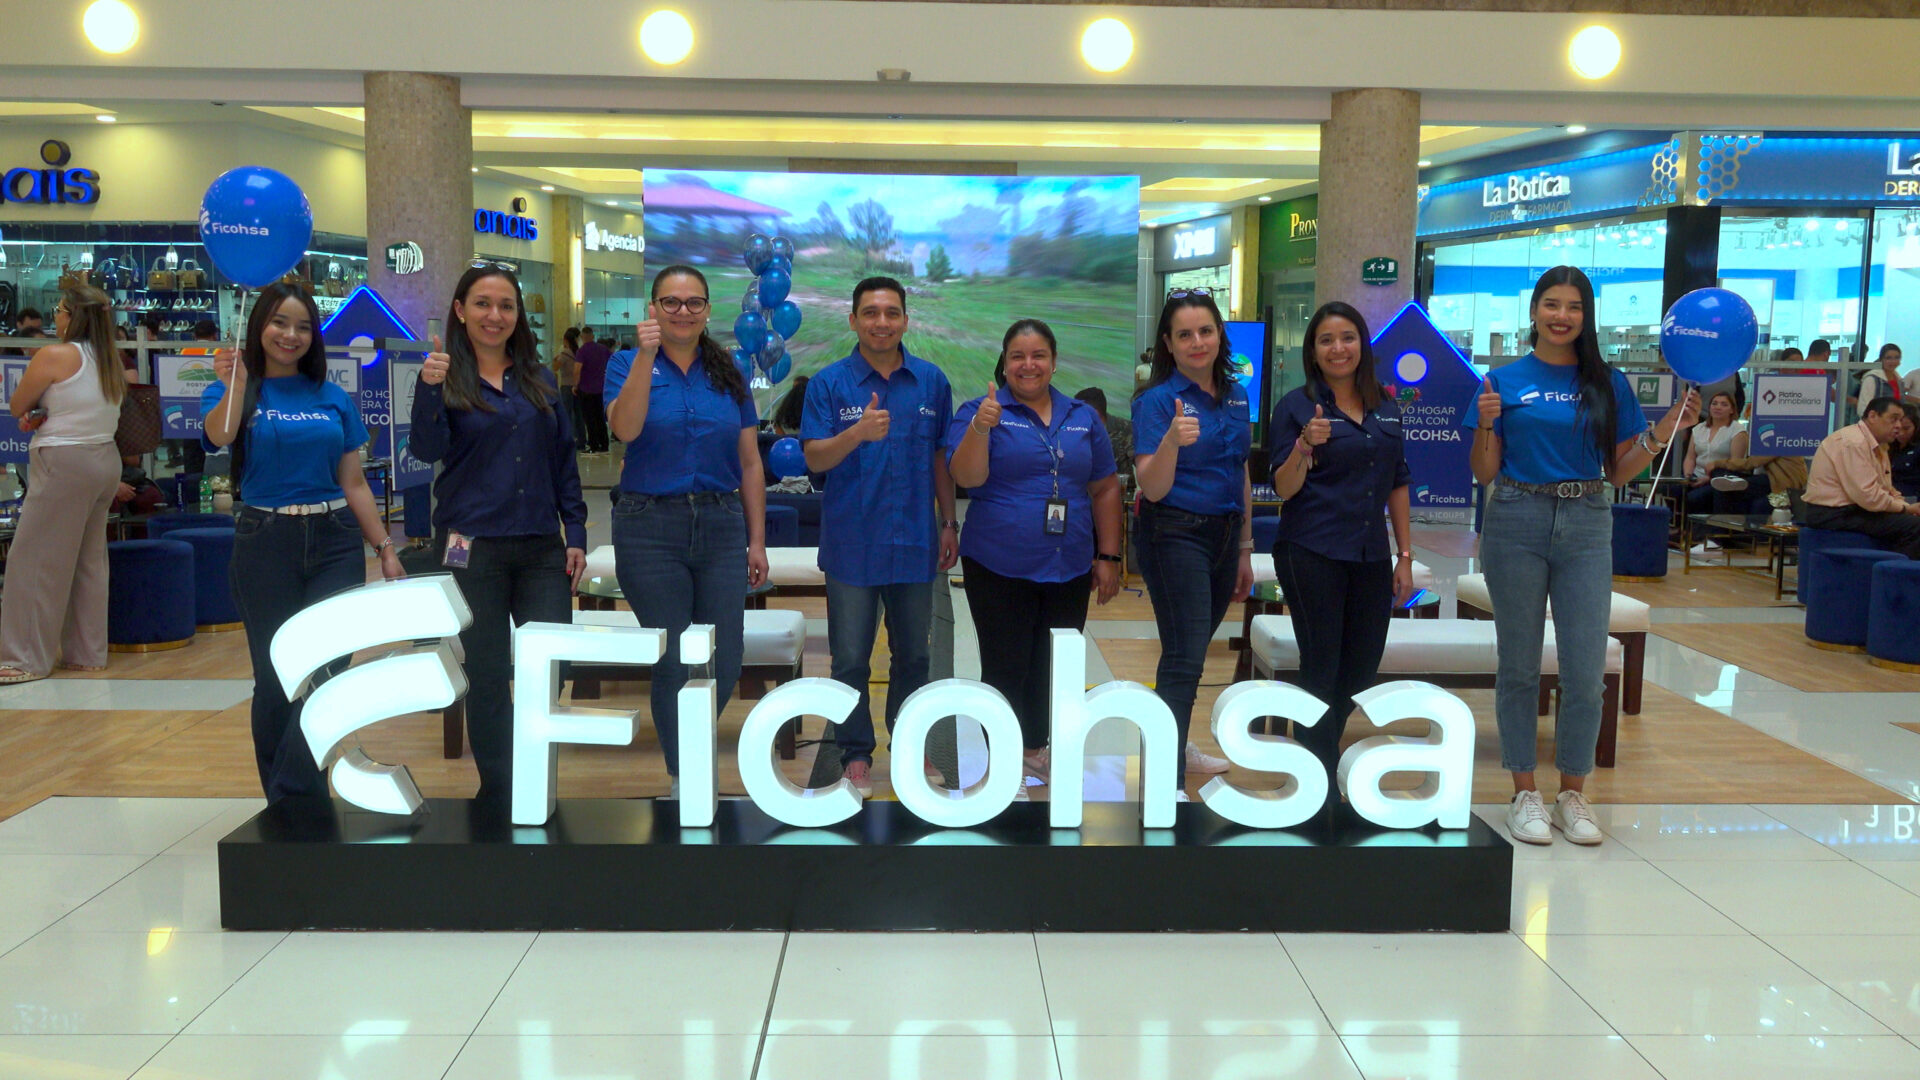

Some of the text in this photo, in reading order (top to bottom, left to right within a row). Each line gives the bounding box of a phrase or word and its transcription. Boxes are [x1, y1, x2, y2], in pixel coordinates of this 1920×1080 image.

[0, 139, 101, 204] ais
[1483, 171, 1571, 207] La Botica
[1884, 181, 1920, 195] DER
[474, 197, 538, 241] anais
[212, 222, 269, 236] Ficohsa
[601, 230, 636, 251] Agencia
[1673, 325, 1719, 339] Ficohsa
[1639, 381, 1657, 393] AV
[265, 409, 331, 422] Ficohsa
[839, 406, 863, 416] CASA
[1417, 407, 1456, 416] HOGAR
[1425, 416, 1449, 426] CON
[1775, 436, 1820, 448] Ficohsa
[1429, 495, 1466, 504] Ficohsa
[511, 622, 1476, 829] Ficohsa
